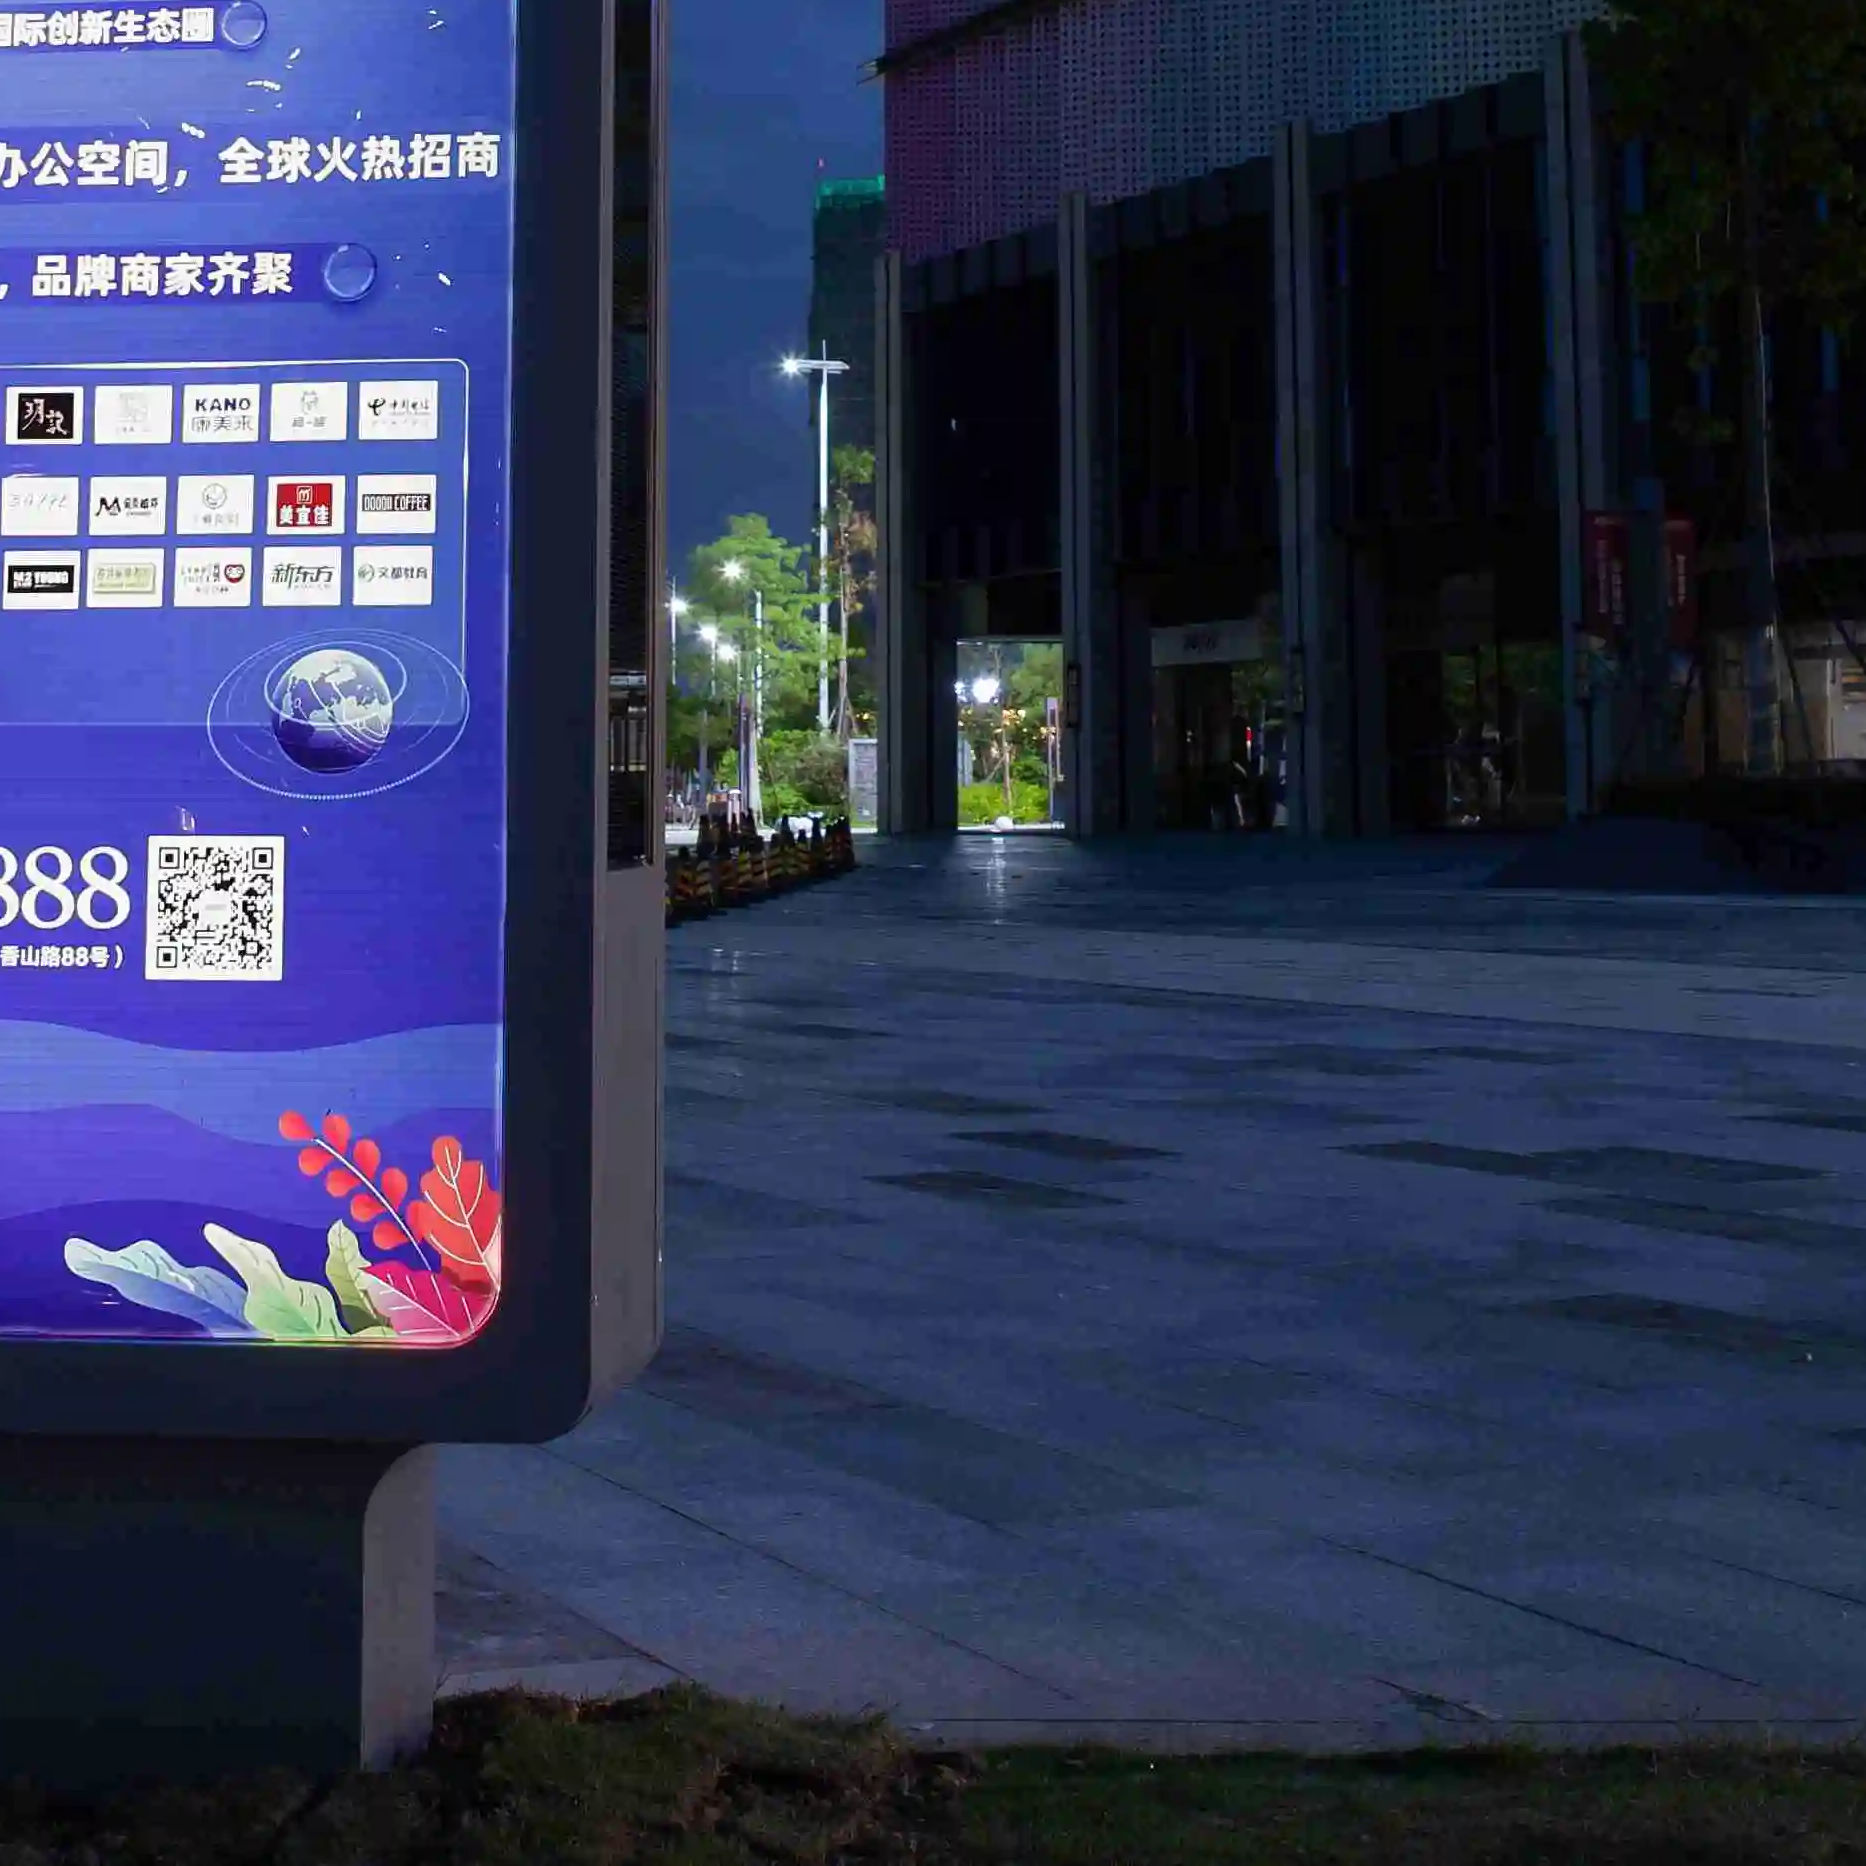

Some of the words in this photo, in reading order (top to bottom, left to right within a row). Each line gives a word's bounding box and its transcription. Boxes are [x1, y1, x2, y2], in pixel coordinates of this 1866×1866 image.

[195, 397, 252, 412] KANO
[394, 494, 429, 511] COFFEE
[278, 504, 330, 525] 美宜佳
